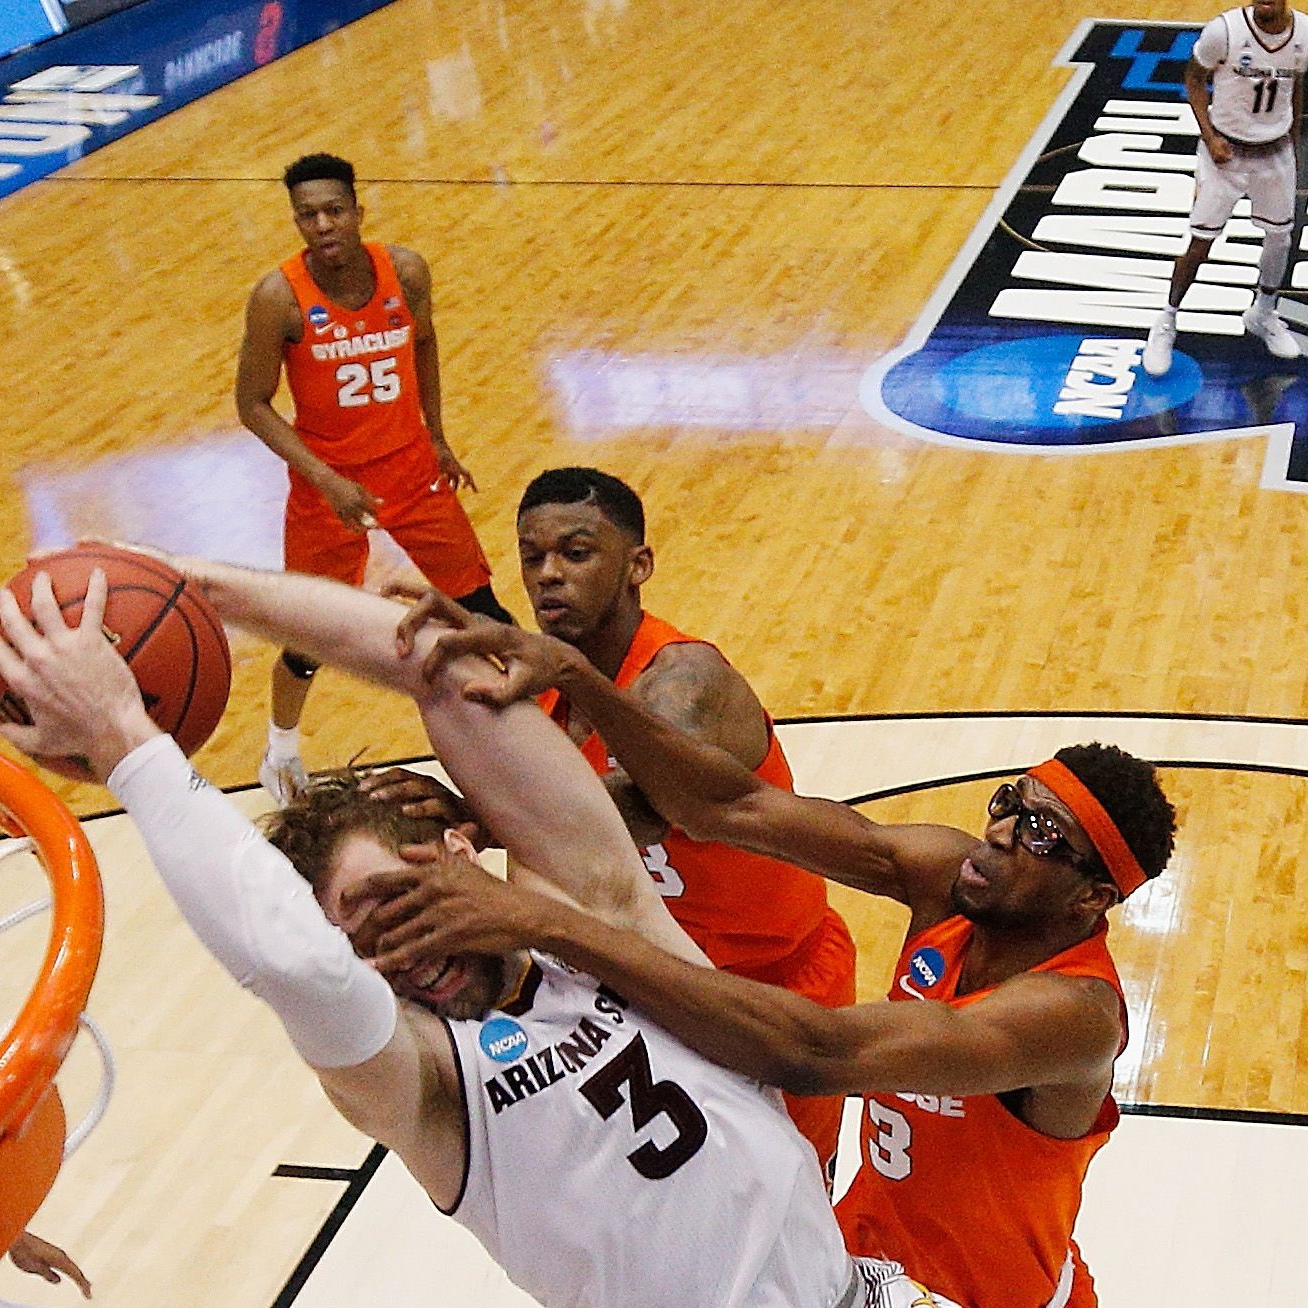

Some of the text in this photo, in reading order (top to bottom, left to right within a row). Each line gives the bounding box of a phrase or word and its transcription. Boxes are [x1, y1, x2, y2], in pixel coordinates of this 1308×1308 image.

[1252, 79, 1278, 114] 11
[311, 326, 411, 361] SYRACUSE
[335, 356, 401, 408] 25
[1053, 338, 1148, 419] NCAA
[912, 954, 937, 987] NCAA
[488, 1029, 528, 1057] NCAA
[578, 1029, 709, 1181] 3
[867, 1097, 913, 1182] 3
